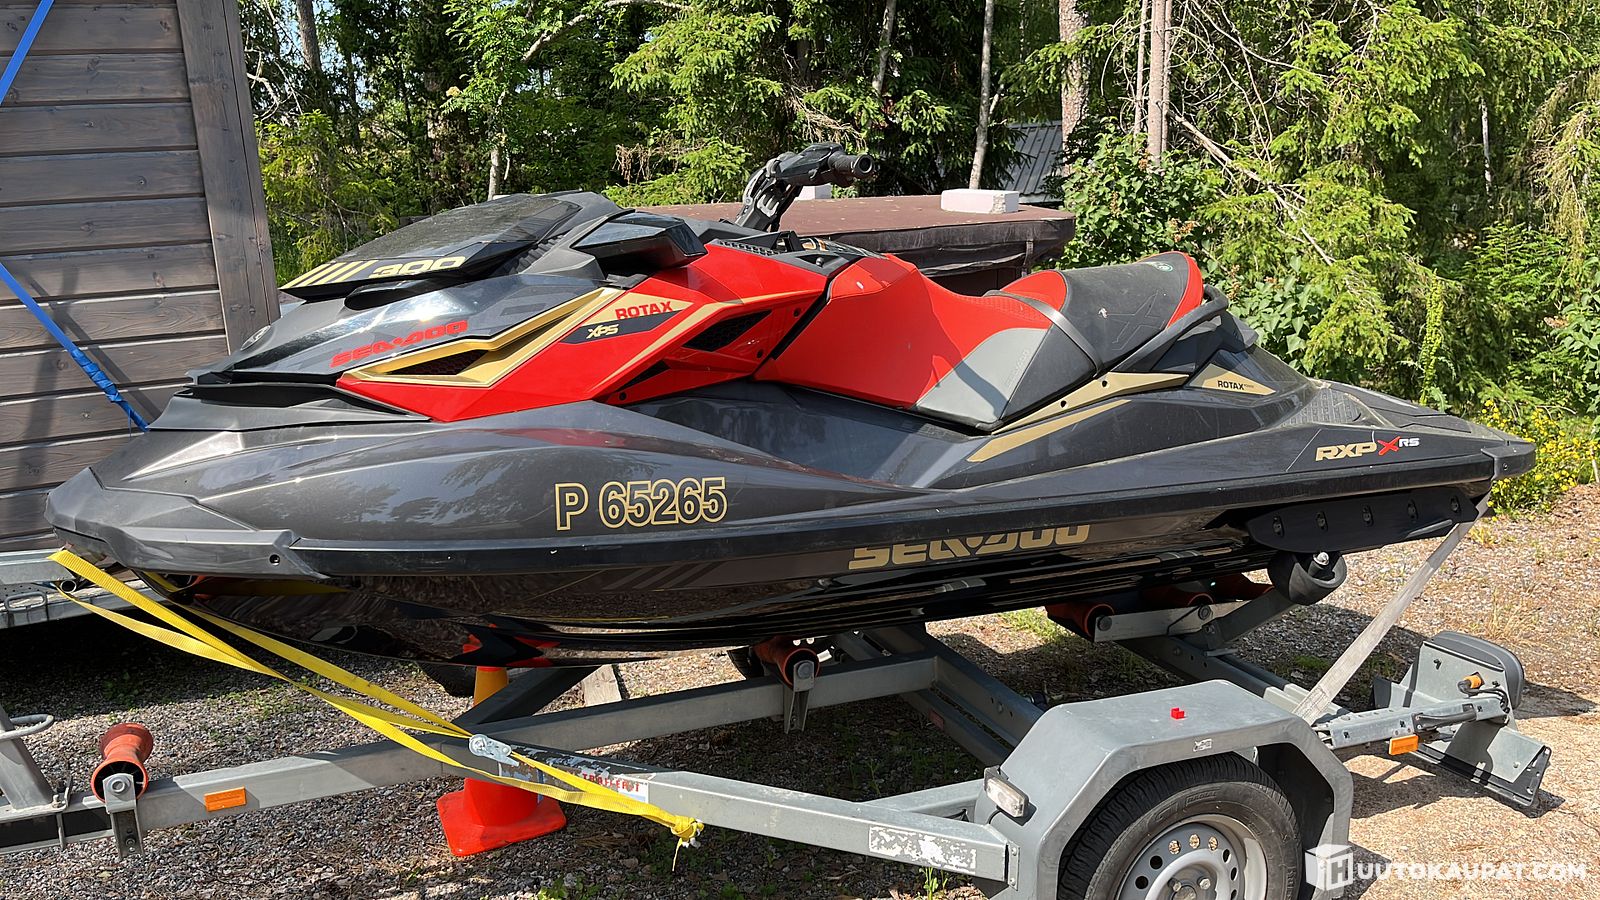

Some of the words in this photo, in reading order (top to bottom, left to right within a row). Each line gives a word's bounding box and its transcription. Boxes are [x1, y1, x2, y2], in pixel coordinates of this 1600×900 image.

[368, 256, 466, 279] 300
[615, 301, 673, 320] ROTAX
[586, 323, 620, 339] XPS
[1217, 380, 1245, 391] ROTAX
[1315, 441, 1378, 462] RXP
[554, 482, 589, 531] P
[598, 476, 729, 529] 65265
